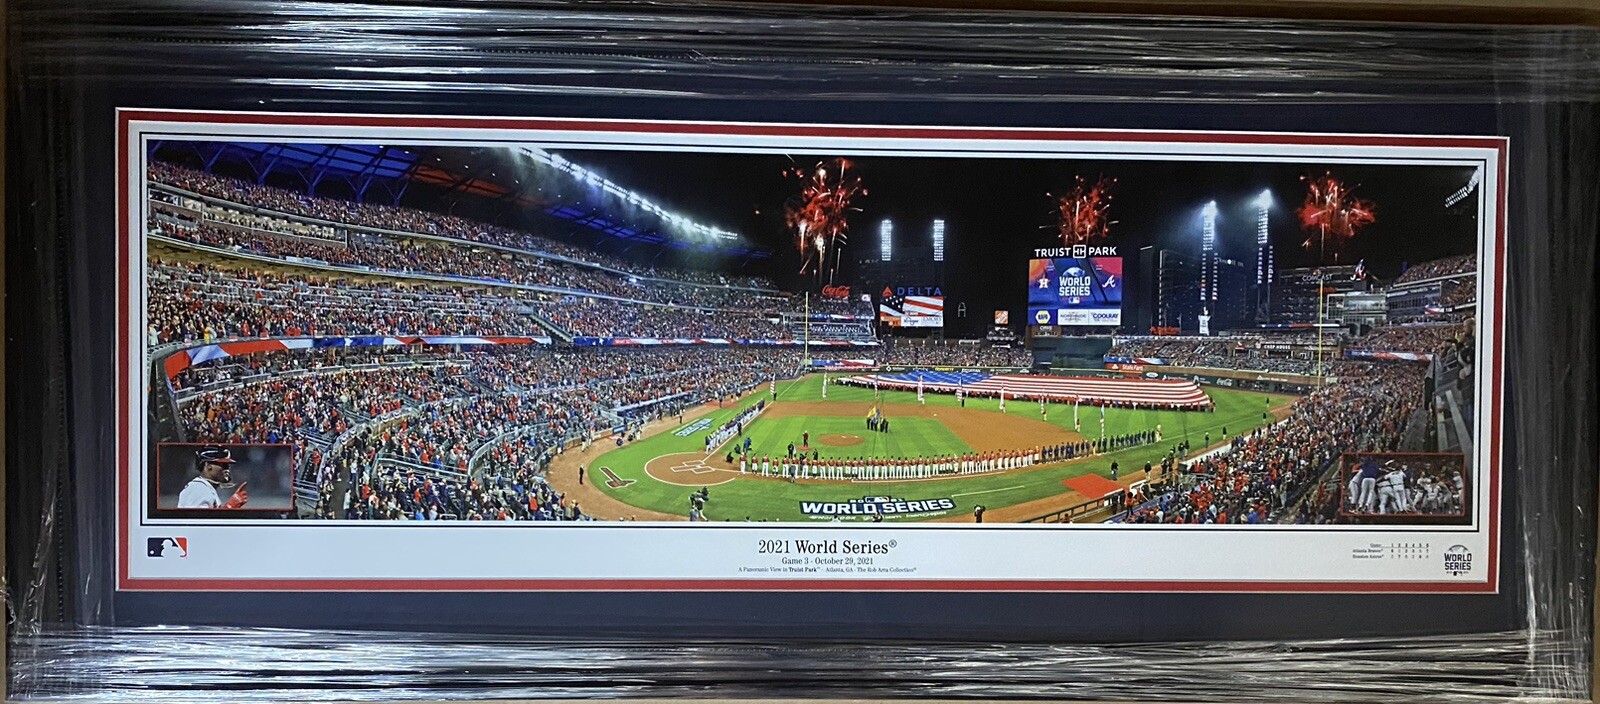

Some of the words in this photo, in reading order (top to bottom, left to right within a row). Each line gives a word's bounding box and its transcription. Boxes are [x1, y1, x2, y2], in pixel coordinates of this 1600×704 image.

[1034, 247, 1071, 257] TRUIST
[1088, 246, 1117, 256] PARK
[1059, 276, 1091, 287] WORLD
[896, 286, 943, 296] DELTA
[1059, 286, 1091, 296] SERIES
[802, 501, 877, 514] WORLD
[883, 498, 954, 513] SERIES
[758, 539, 790, 554] 2021
[795, 539, 837, 554] World
[842, 539, 898, 554] Series®
[781, 557, 803, 565] Game
[804, 557, 809, 565] 3
[814, 557, 843, 565] October
[845, 557, 856, 566] 29,
[857, 557, 874, 565] 2021
[1444, 553, 1472, 562] WORLD
[1444, 562, 1472, 571] SERIES
